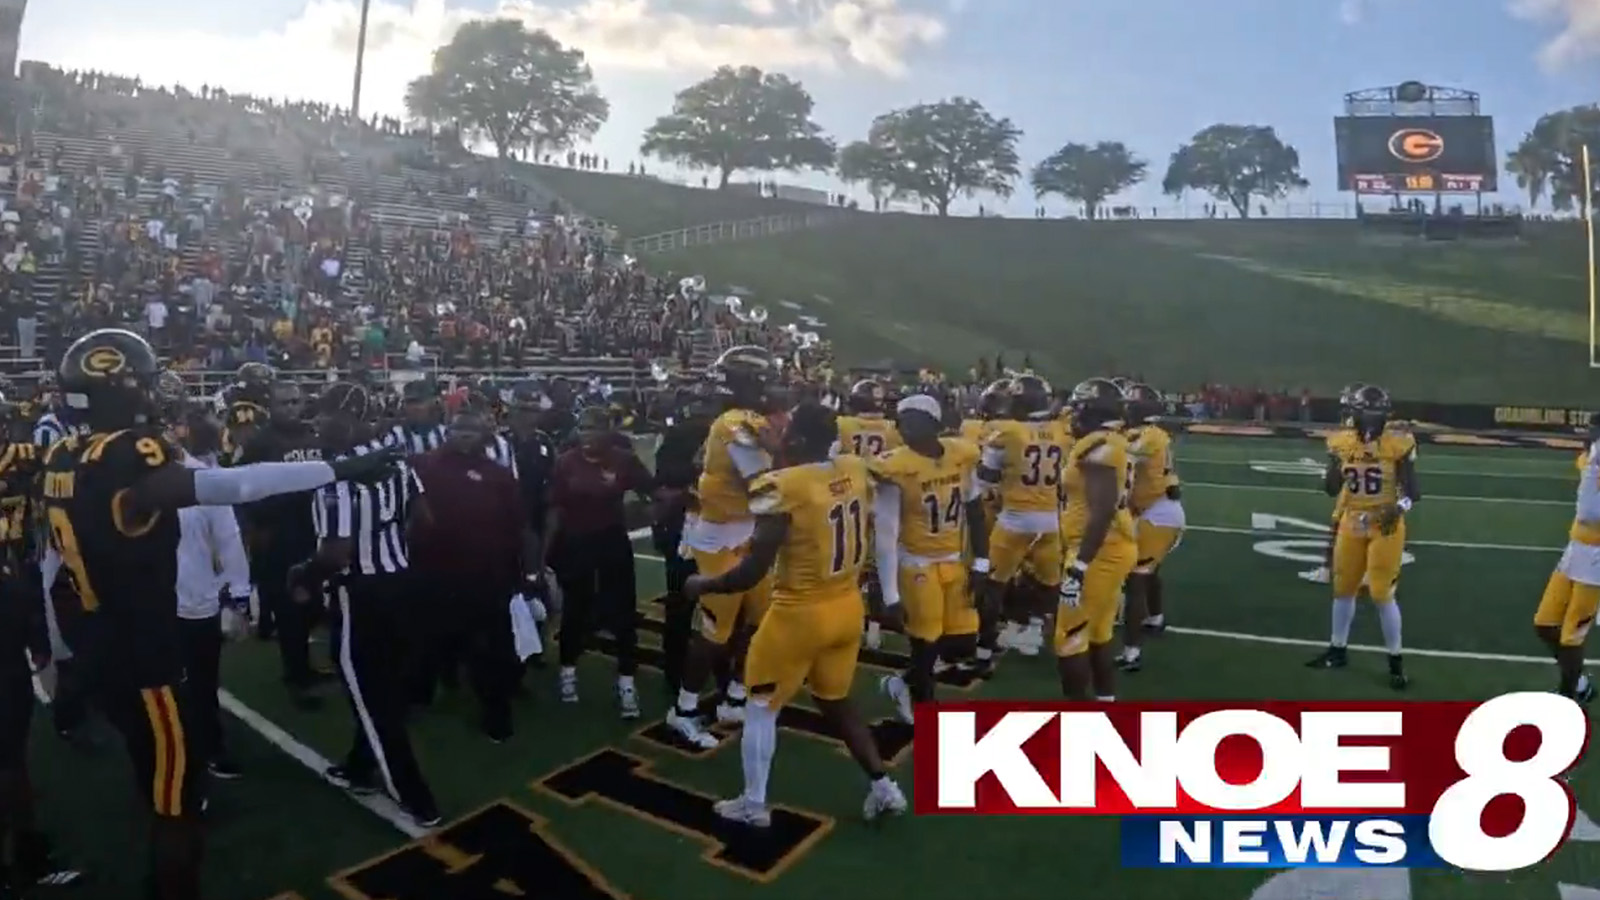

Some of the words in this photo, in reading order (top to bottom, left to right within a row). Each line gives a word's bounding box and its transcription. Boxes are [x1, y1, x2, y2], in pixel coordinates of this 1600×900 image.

[135, 436, 166, 466] 9
[283, 447, 323, 462] POLICE
[1021, 444, 1063, 486] 33
[922, 486, 963, 534] 14
[828, 498, 864, 574] 11
